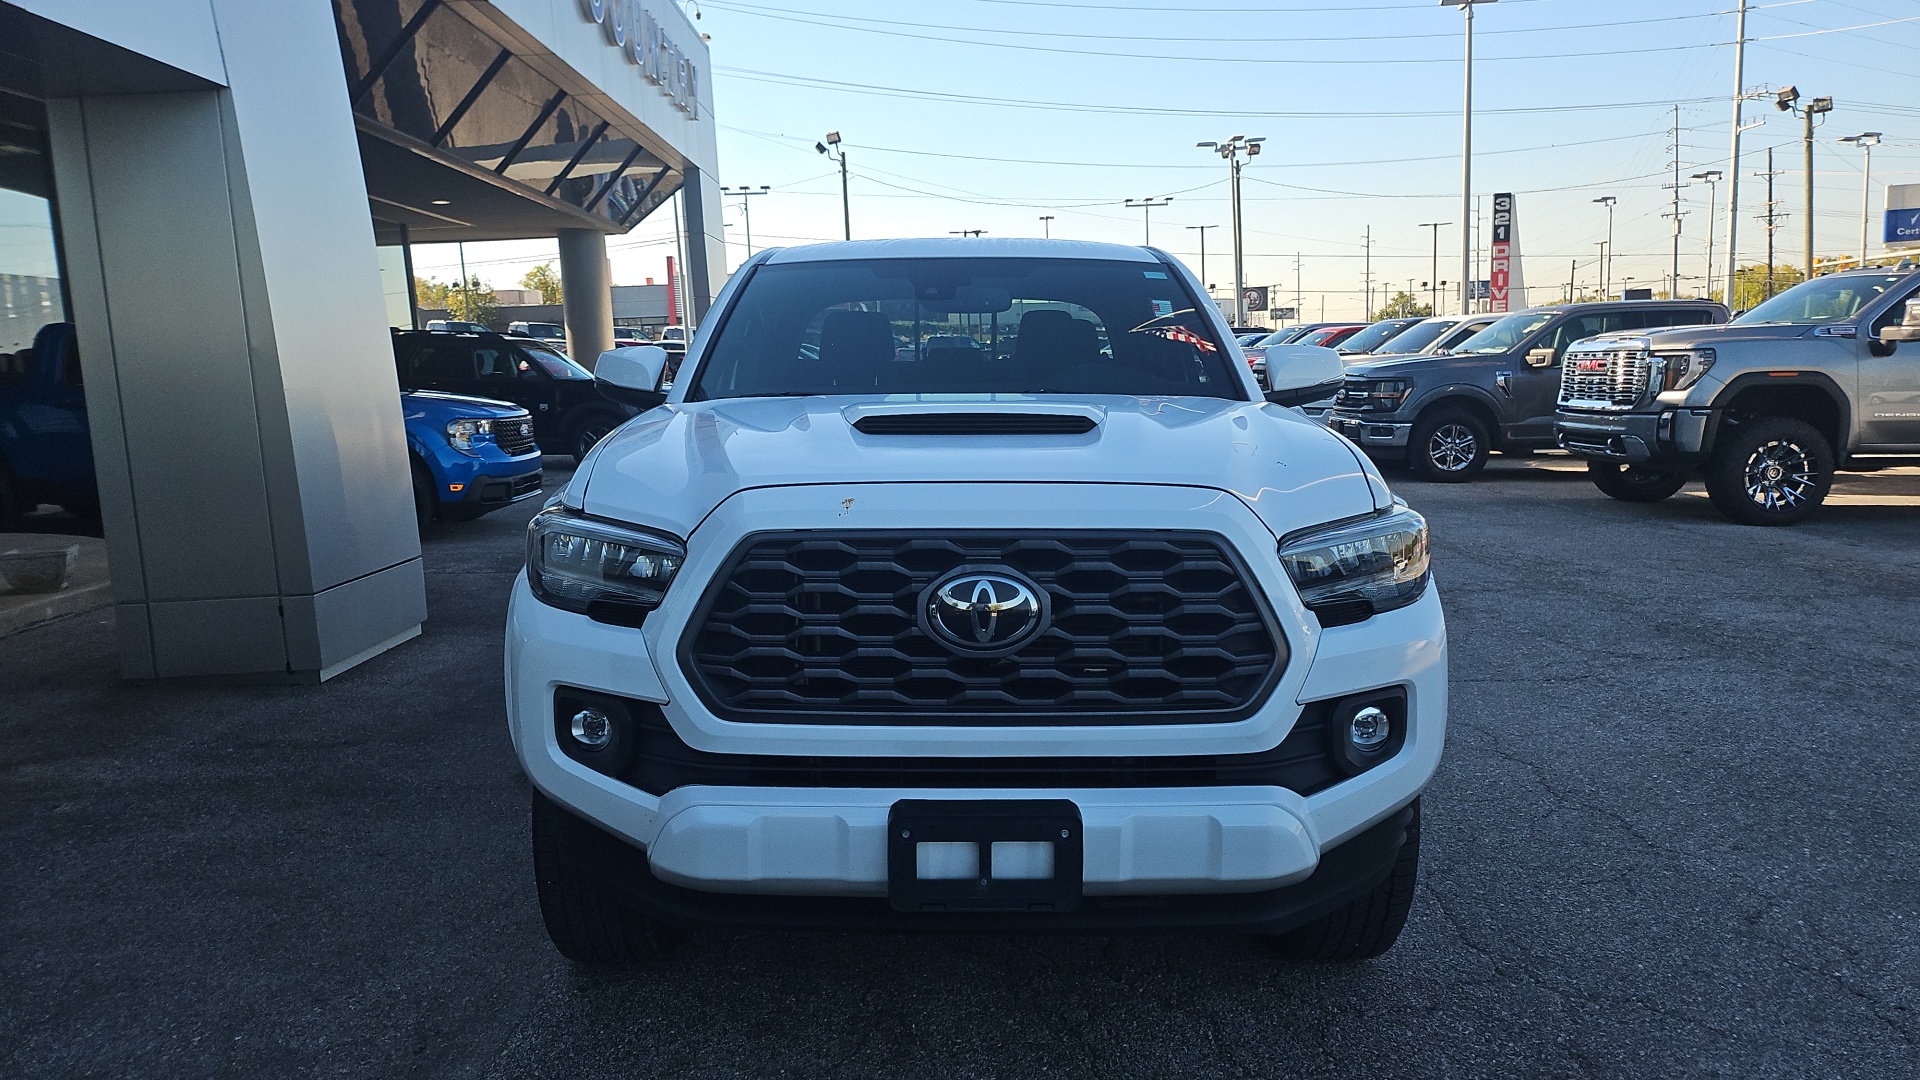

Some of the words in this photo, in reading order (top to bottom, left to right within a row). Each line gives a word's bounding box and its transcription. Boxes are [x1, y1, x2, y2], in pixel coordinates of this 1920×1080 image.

[581, 0, 699, 120] OUNTRY
[1495, 198, 1510, 239] 321
[1492, 245, 1509, 312] DRIVE
[1577, 359, 1607, 371] GMC
